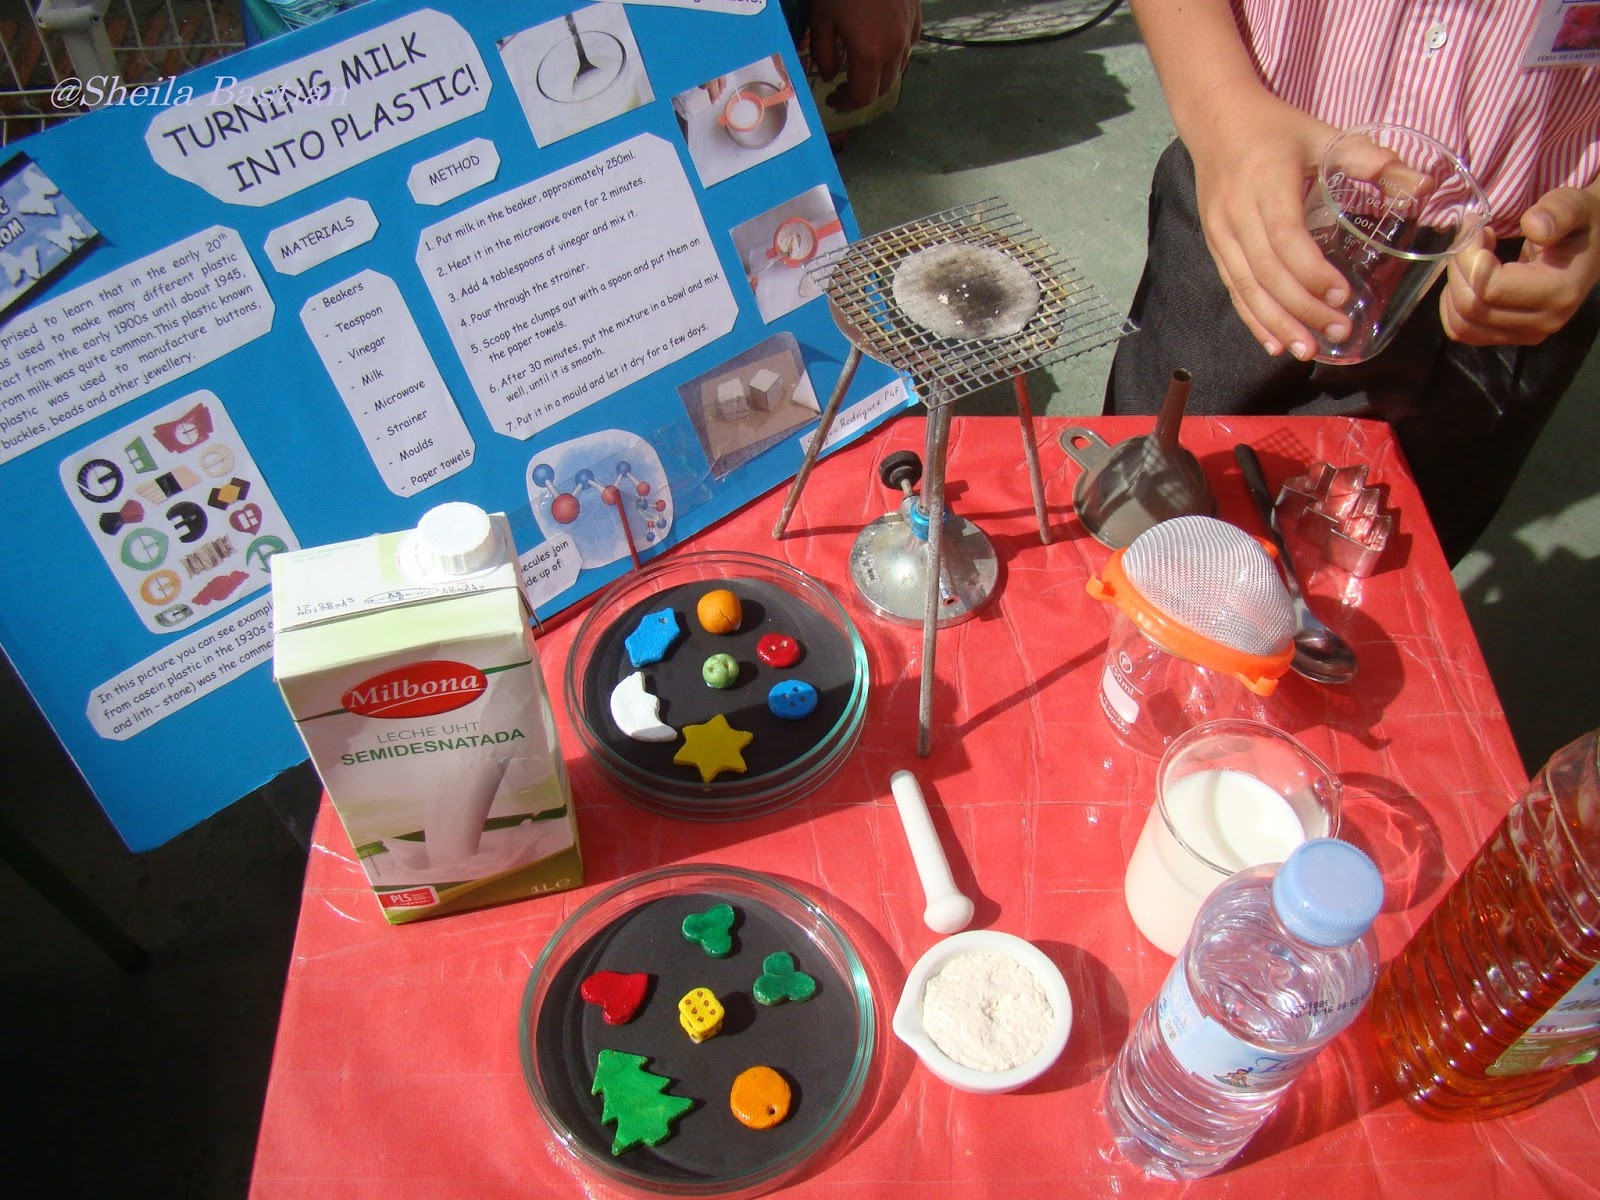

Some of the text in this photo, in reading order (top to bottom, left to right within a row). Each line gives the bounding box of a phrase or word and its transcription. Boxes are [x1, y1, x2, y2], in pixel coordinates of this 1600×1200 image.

[162, 32, 427, 157] TURNING MILK
[227, 64, 479, 192] INTO PLASTIC!
[429, 155, 480, 186] METHOD
[435, 150, 636, 246] Put milk the beaker, approximately 250ml.
[0, 217, 25, 249] OM
[280, 216, 354, 259] MATERIALS
[447, 177, 646, 272] Heat the microwave oven for minutes.
[461, 215, 626, 298] Add tablespoons vinegar and mix
[0, 322, 38, 350] prised
[44, 316, 57, 327] to
[62, 300, 94, 318] learn
[98, 284, 123, 301] that
[130, 278, 142, 287] in
[146, 266, 167, 279] the
[173, 250, 200, 268] early
[17, 254, 237, 360] used to make many different plastic
[322, 282, 364, 308] Beakers
[335, 306, 383, 333] Teaspoon
[470, 263, 589, 324] Pour through the strainer.
[470, 244, 689, 354] 5. Scoop the clumps out with spoon and put them
[26, 268, 246, 377] from the early 1900s until about 1945,
[27, 379, 52, 397] milk
[53, 368, 76, 384] was
[78, 354, 107, 374] quite
[181, 302, 218, 326] plastic
[218, 285, 253, 305] known
[347, 336, 385, 359] Vinegar
[489, 320, 567, 363] the paper towels.
[501, 273, 719, 388] After 30 minutes, put the mixture bowl and mix
[0, 301, 261, 433] plastic was used to manufacture buttons,
[361, 369, 384, 386] Milk
[505, 323, 708, 432] 7. Put it in mould and let dry for few days.
[506, 347, 605, 402] well, until it is smooth.
[1, 352, 196, 449] buckles, beads and other jewellery.
[374, 381, 425, 412] Microwave
[387, 410, 427, 436] Strainer
[399, 438, 434, 462] Moulds
[410, 449, 471, 486] Paper towels
[539, 558, 561, 578] up of
[551, 541, 569, 557] join
[97, 625, 236, 704] In this picture you can see
[104, 625, 266, 719] from casein plastic in the 1930s
[348, 674, 480, 709] Milbona
[113, 661, 237, 734] and lith stone) was the
[341, 728, 525, 765] SEMIDESNATADA
[377, 721, 480, 743] LECHE UHT
[389, 893, 413, 904] PLS
